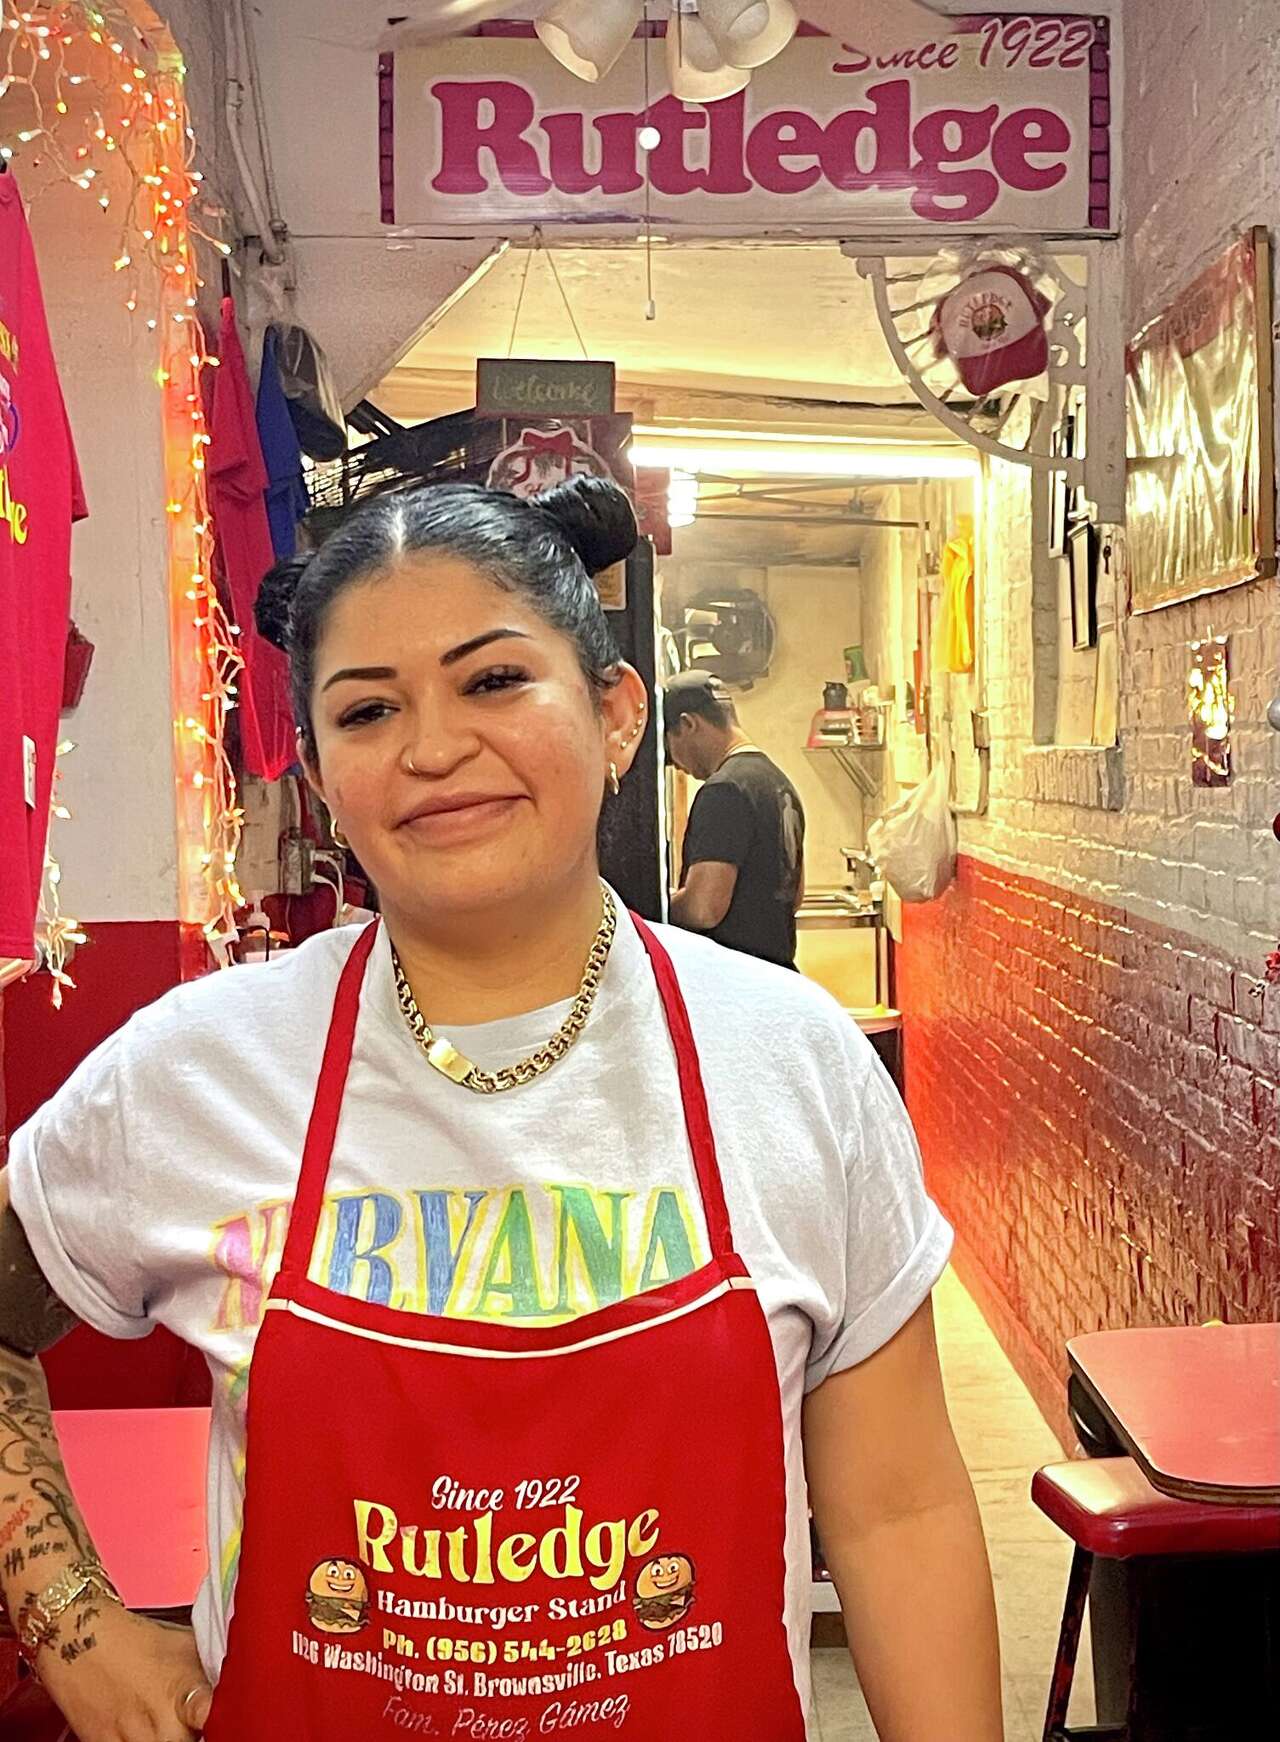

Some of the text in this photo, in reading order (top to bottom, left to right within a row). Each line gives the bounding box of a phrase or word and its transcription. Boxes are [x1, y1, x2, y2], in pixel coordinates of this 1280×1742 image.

[978, 16, 1095, 68] 1922
[430, 79, 1073, 222] Rutledge
[212, 1184, 703, 1328] NRVANA
[431, 1475, 581, 1511] Since 1922
[353, 1498, 661, 1591] Rutledge
[376, 1579, 627, 1630] Hamburger Stand
[292, 1630, 319, 1665] 1126
[323, 1643, 440, 1692] Washington
[604, 1650, 665, 1677] Texas
[667, 1621, 723, 1659] 78520
[382, 1618, 628, 1665] Ph. (956) 544-2628
[382, 1696, 440, 1736] Fam.
[539, 1693, 631, 1735] Gámez
